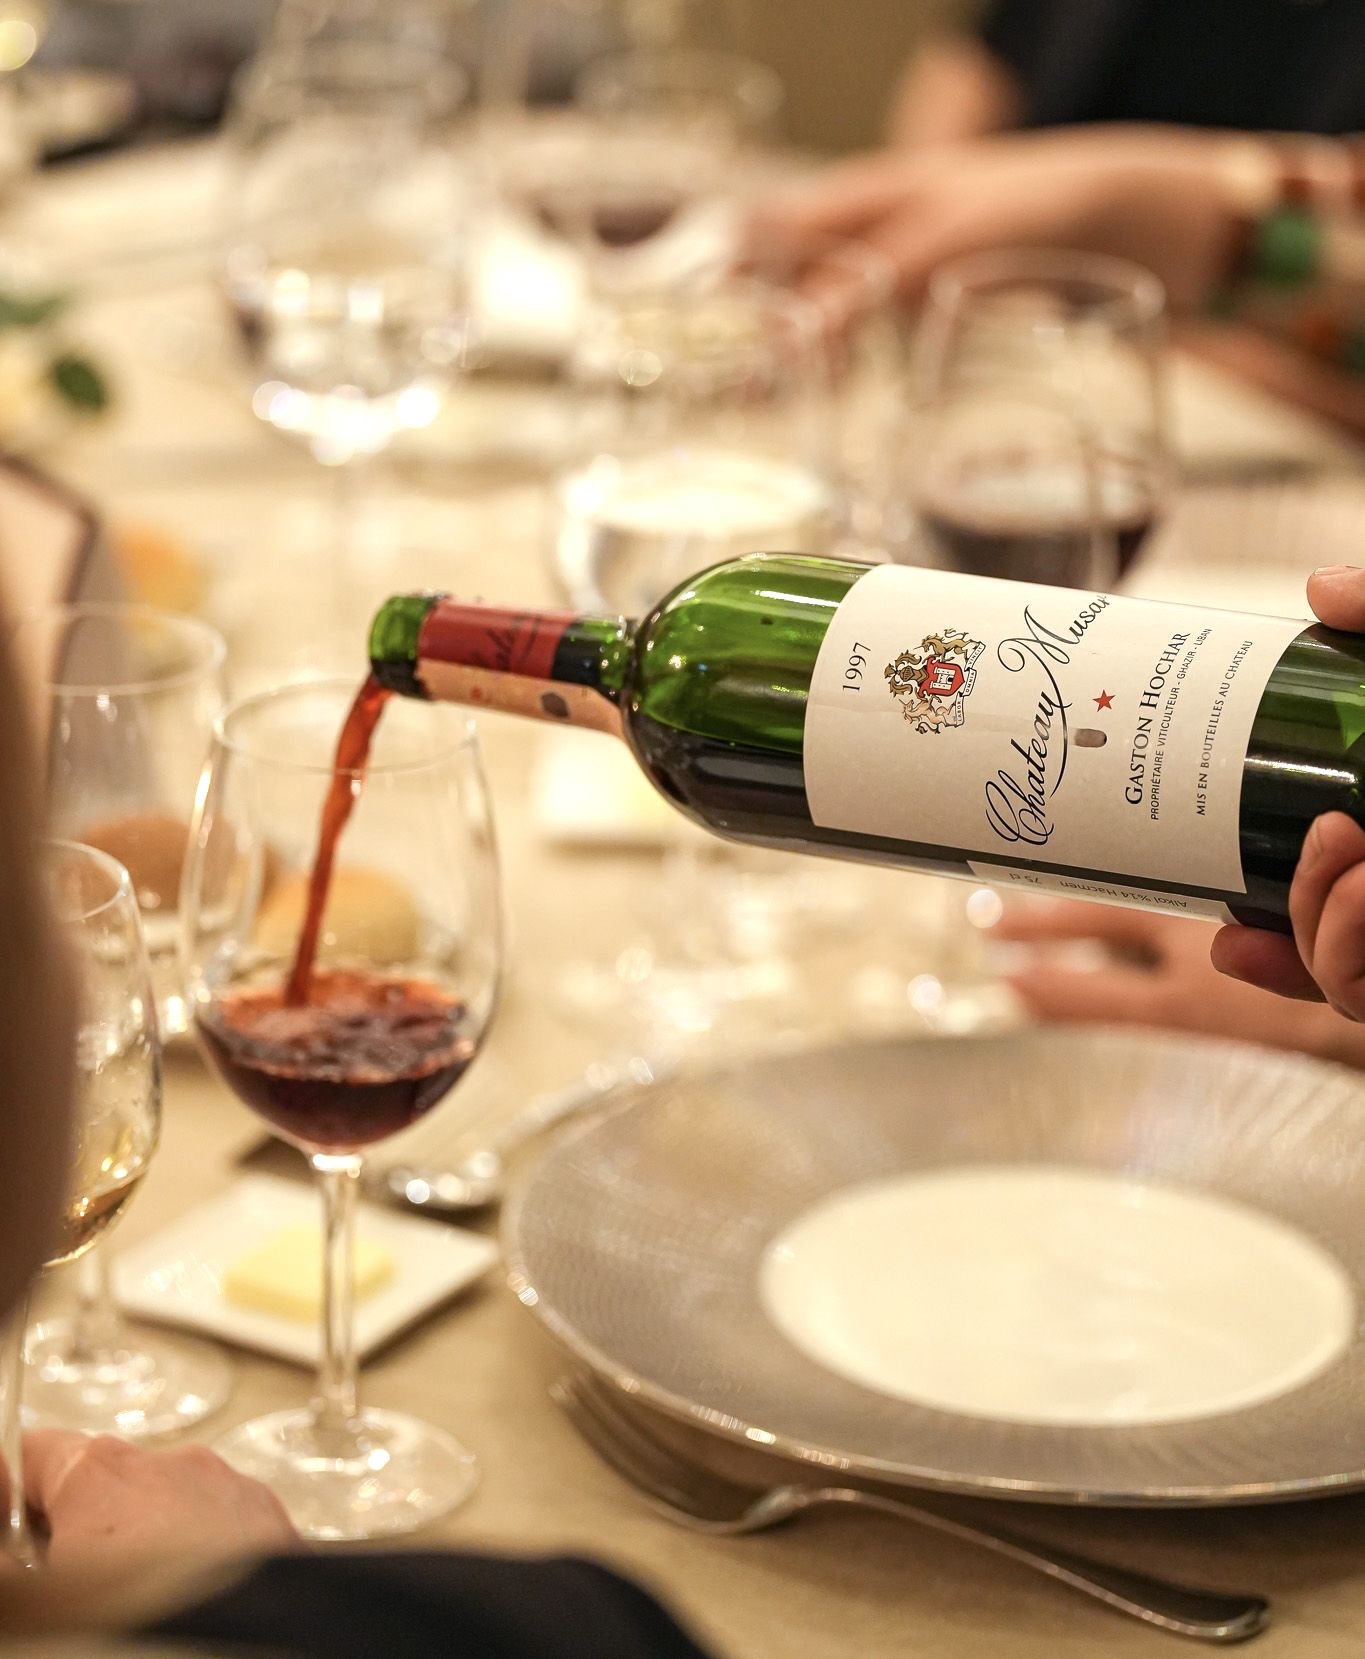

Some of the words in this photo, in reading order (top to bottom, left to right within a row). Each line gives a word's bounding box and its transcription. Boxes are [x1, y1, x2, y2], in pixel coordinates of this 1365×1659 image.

[1193, 628, 1213, 646] LIBAN
[843, 642, 871, 692] 1997
[968, 645, 982, 666] VINCIT
[1176, 650, 1197, 680] GHAZIR
[1224, 640, 1254, 680] CHATEAU
[966, 671, 975, 693] OMNIA
[1218, 682, 1231, 698] AU
[1125, 716, 1153, 805] GASTON
[1139, 633, 1191, 709] HOCHAR
[1156, 687, 1180, 747] VITICULTEUR
[1200, 699, 1225, 769] BOUTEILLES
[985, 691, 1073, 846] Chateau
[1150, 749, 1165, 821] PROPRIÉTAIRE
[1197, 772, 1208, 790] EN
[1196, 792, 1207, 816] MIS
[1024, 874, 1042, 885] 75
[1058, 880, 1117, 897] Hacmen
[1120, 890, 1151, 903] %14
[1154, 896, 1187, 909] Alkol
